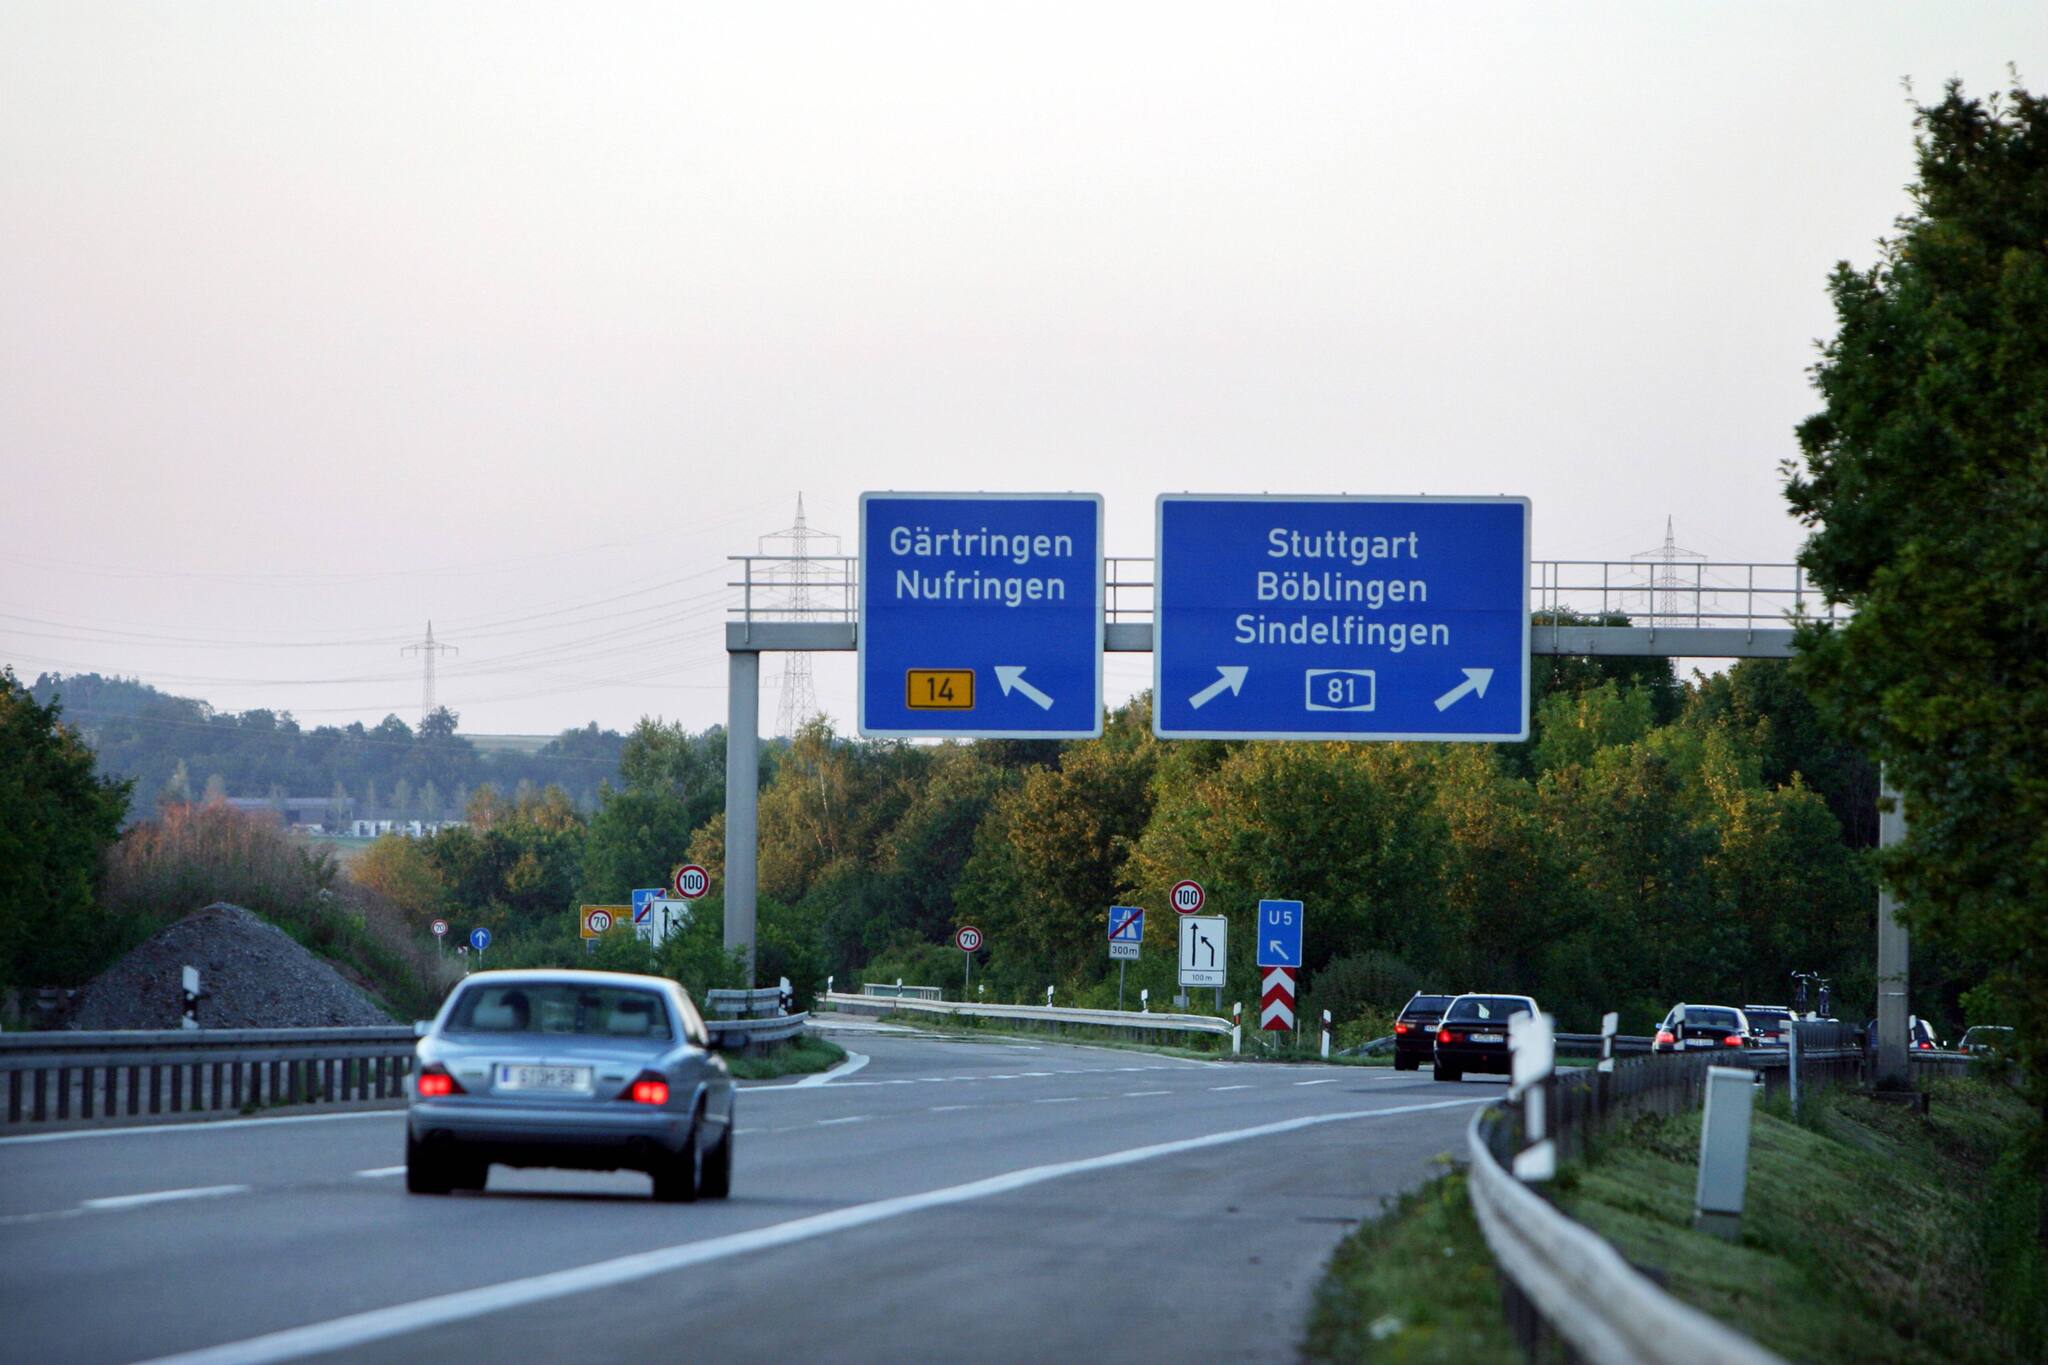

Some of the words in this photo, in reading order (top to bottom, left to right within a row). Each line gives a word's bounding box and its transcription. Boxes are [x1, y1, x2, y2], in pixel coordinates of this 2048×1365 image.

[890, 526, 1073, 565] Gärtringen
[1267, 527, 1419, 566] Stuttgart
[896, 570, 1065, 607] Nufringen
[1257, 571, 1427, 609] Böblingen
[1234, 614, 1449, 653] Sindelfingen
[927, 677, 954, 702] 14
[1327, 678, 1355, 703] 81
[682, 874, 703, 890] 100
[1177, 889, 1198, 906] 100
[435, 924, 445, 932] 70
[593, 916, 607, 929] 70
[963, 932, 977, 945] 70
